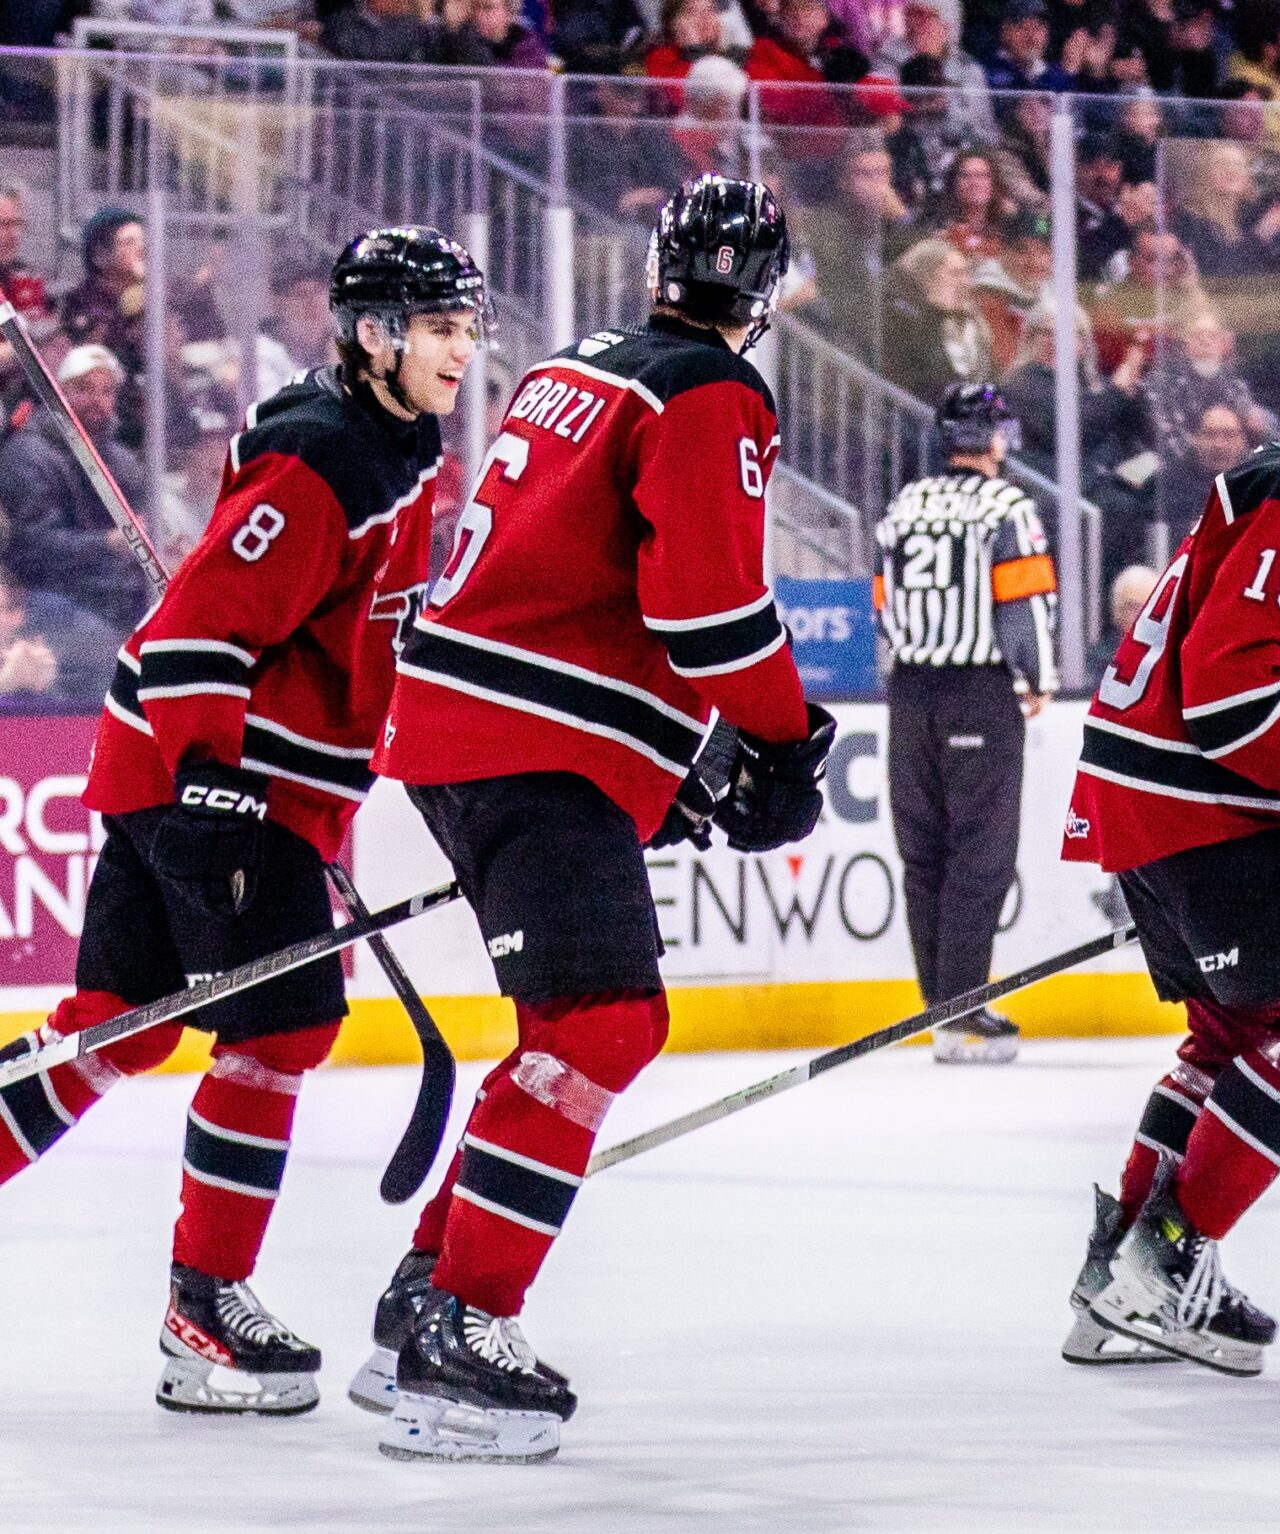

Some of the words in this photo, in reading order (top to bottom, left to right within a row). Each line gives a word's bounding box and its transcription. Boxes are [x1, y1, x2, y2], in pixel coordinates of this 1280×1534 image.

[716, 246, 733, 274] 6
[512, 375, 606, 443] BRIZI
[736, 436, 766, 497] 6
[232, 503, 285, 562] 8
[903, 533, 953, 589] 21
[181, 784, 268, 820] CCM
[818, 731, 879, 825] C
[487, 929, 524, 959] CM
[1194, 946, 1239, 973] CM
